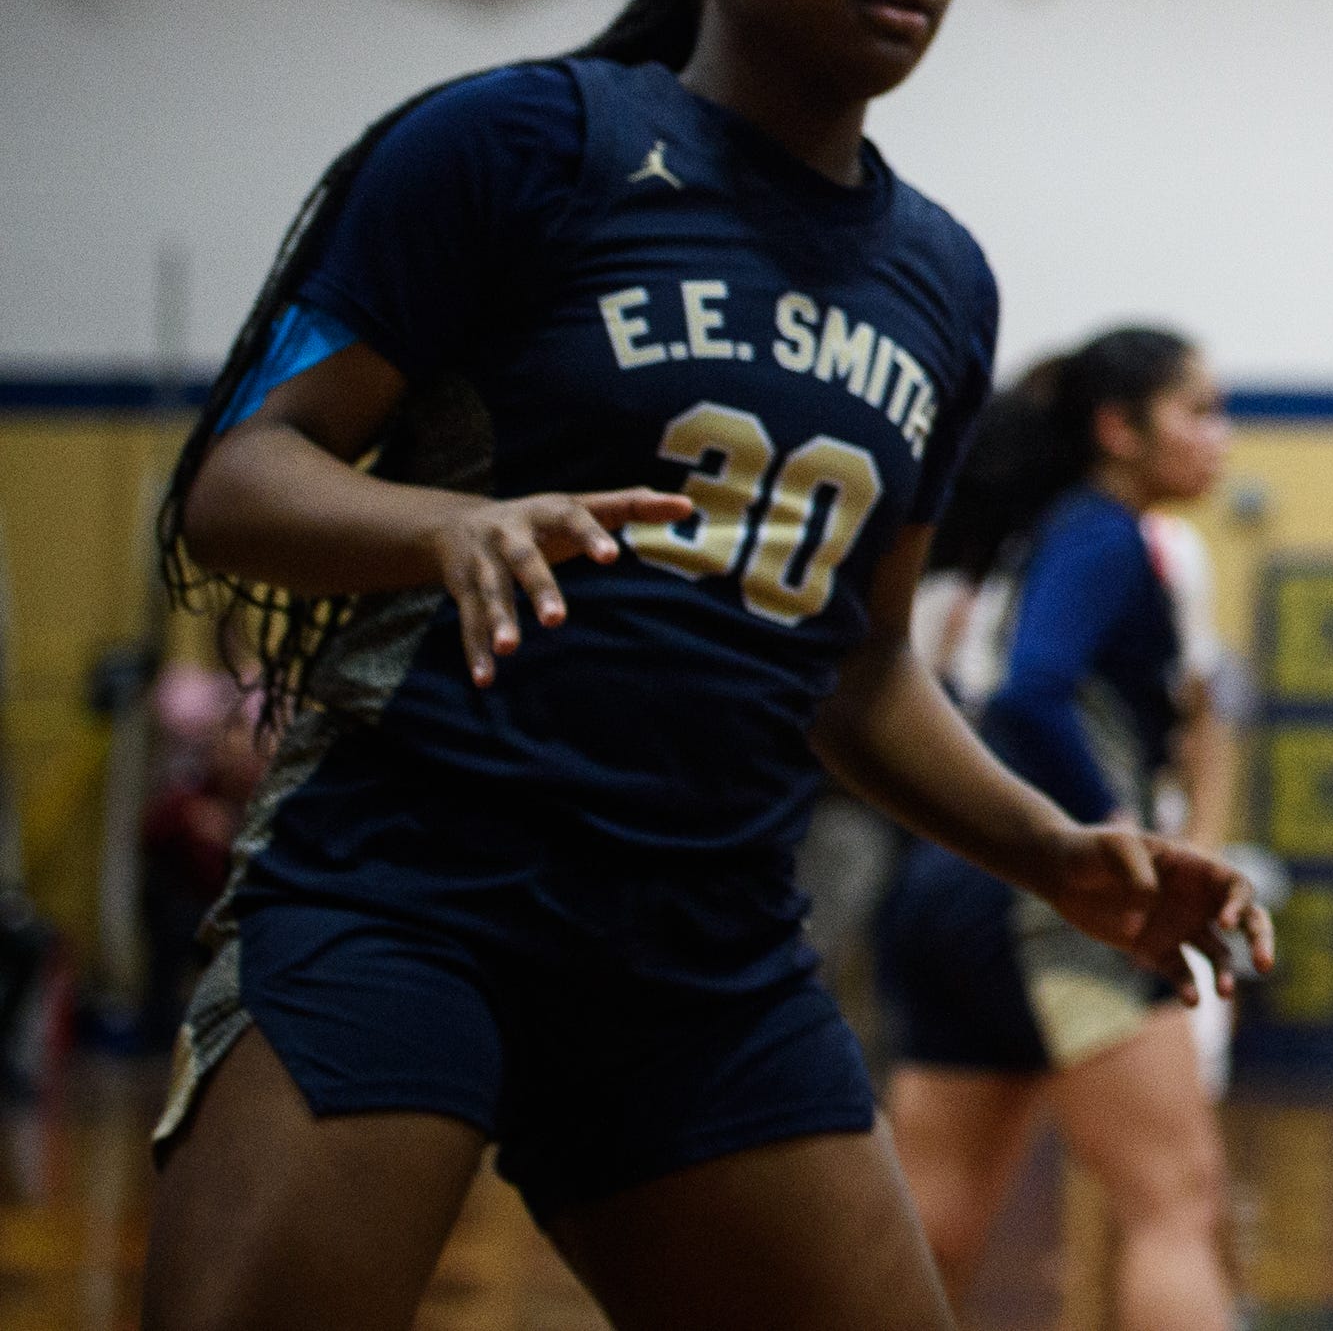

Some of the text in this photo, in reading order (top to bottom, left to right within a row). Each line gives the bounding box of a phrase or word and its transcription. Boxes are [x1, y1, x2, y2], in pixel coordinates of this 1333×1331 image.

[599, 279, 940, 462] E.E. SMITH
[623, 400, 883, 628] 30
